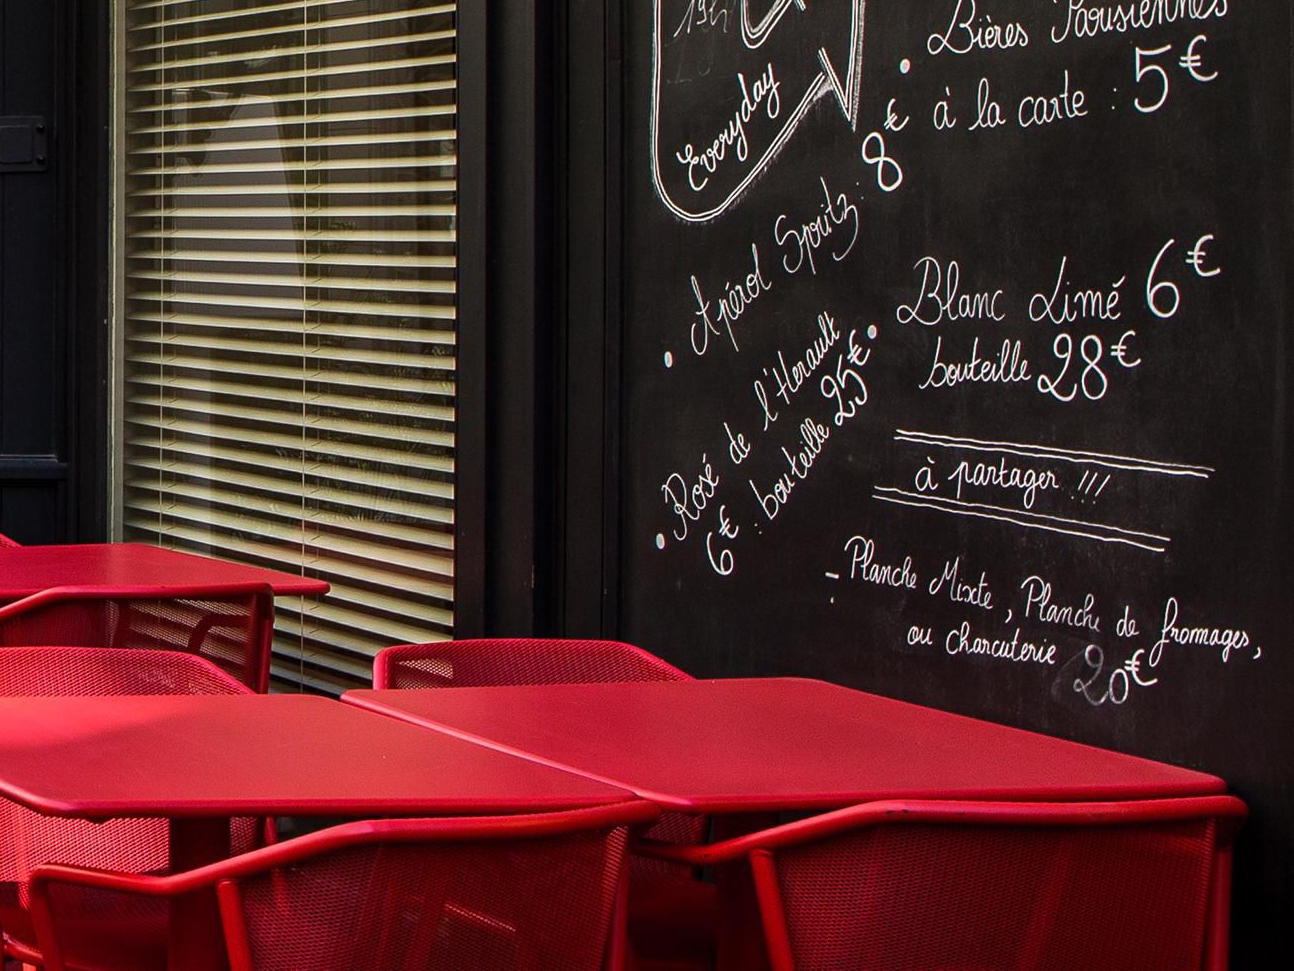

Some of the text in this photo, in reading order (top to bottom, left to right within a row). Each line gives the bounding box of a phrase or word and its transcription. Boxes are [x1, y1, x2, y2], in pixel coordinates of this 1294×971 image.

[676, 62, 781, 192] Everyday
[933, 86, 957, 131] à
[968, 78, 1006, 130] la
[1017, 70, 1089, 128] carte
[1132, 34, 1219, 113] 5€
[691, 242, 773, 356] Apérol
[896, 233, 1221, 326] Blanc Limé 6€
[918, 329, 1142, 402] bouteille 28€
[748, 417, 830, 521] bouteille
[819, 329, 871, 427] 25€
[660, 452, 720, 541] Rosé
[723, 421, 751, 465] de
[914, 456, 939, 492] à
[947, 456, 1060, 509] partager
[843, 535, 917, 590] Planche
[1020, 576, 1101, 632] Planche
[1115, 605, 1140, 638] de
[907, 624, 933, 646] ou
